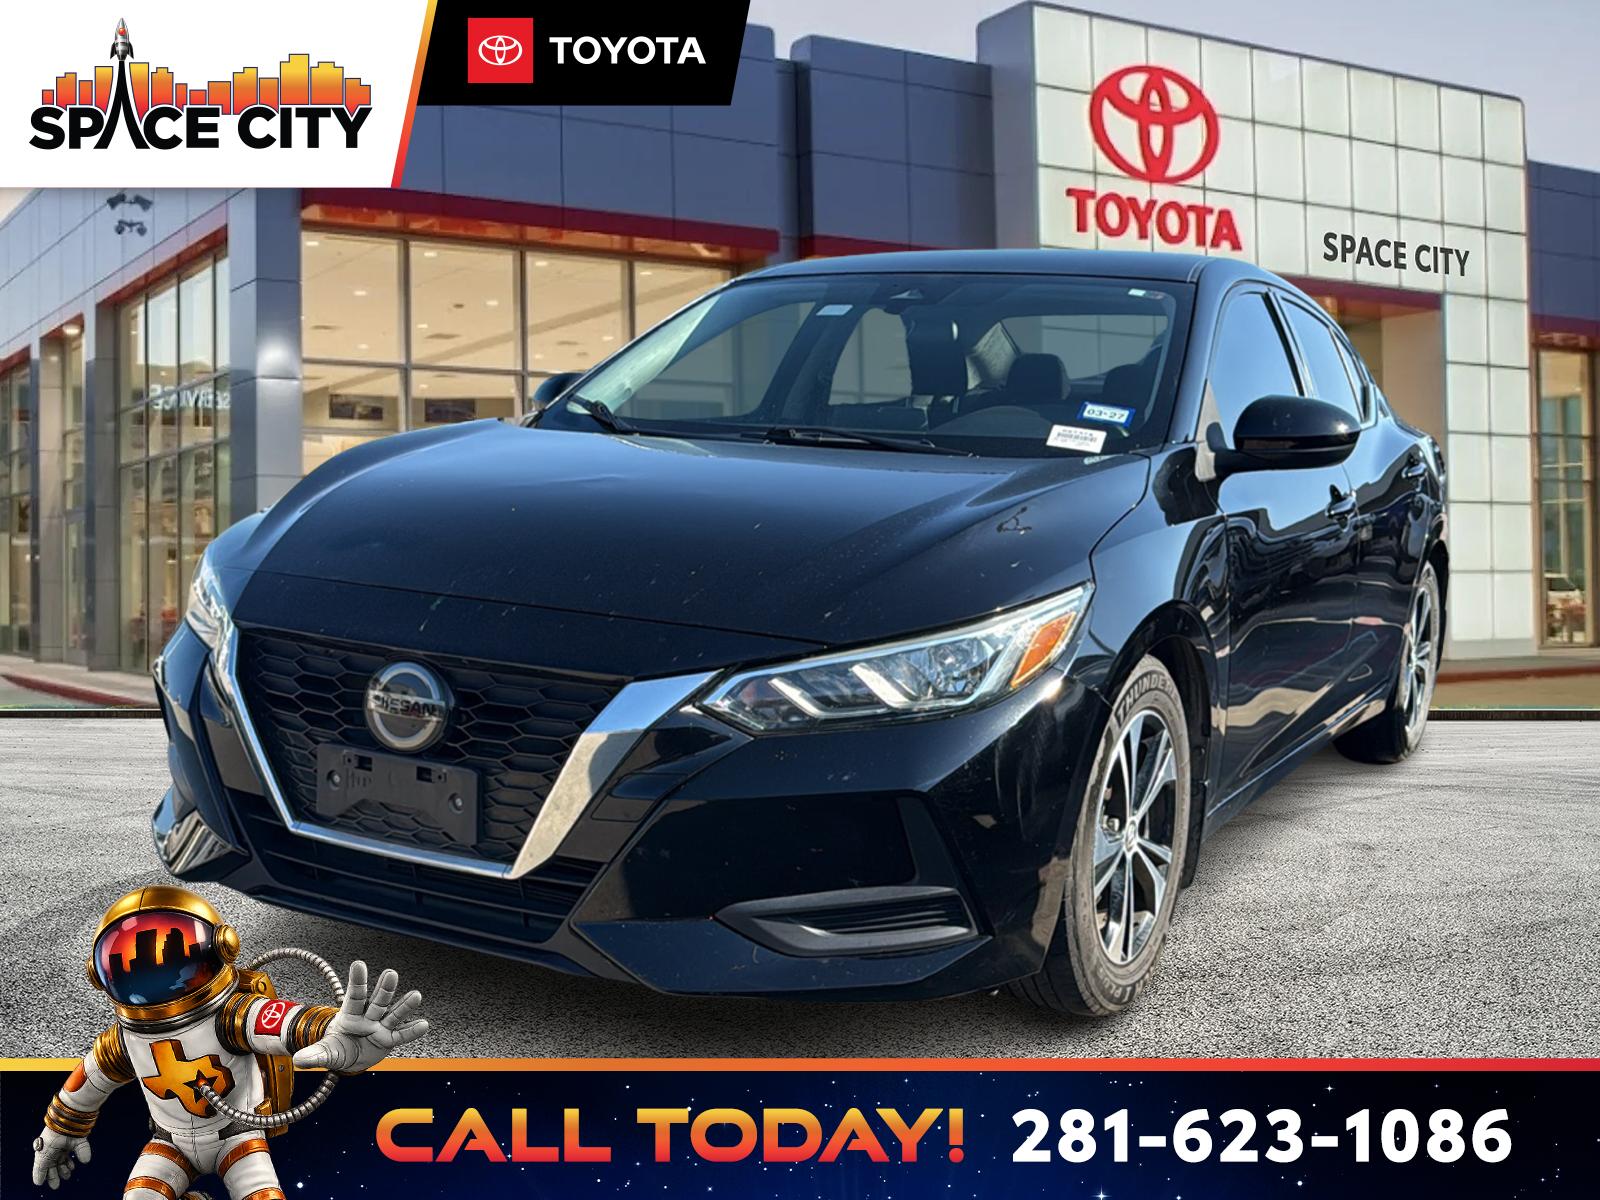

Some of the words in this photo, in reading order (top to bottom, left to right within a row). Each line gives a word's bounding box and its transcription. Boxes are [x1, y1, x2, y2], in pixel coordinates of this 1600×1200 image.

[1066, 187, 1242, 251] TOYOTA
[1323, 231, 1407, 270] SPACE
[1414, 244, 1470, 277] CITY
